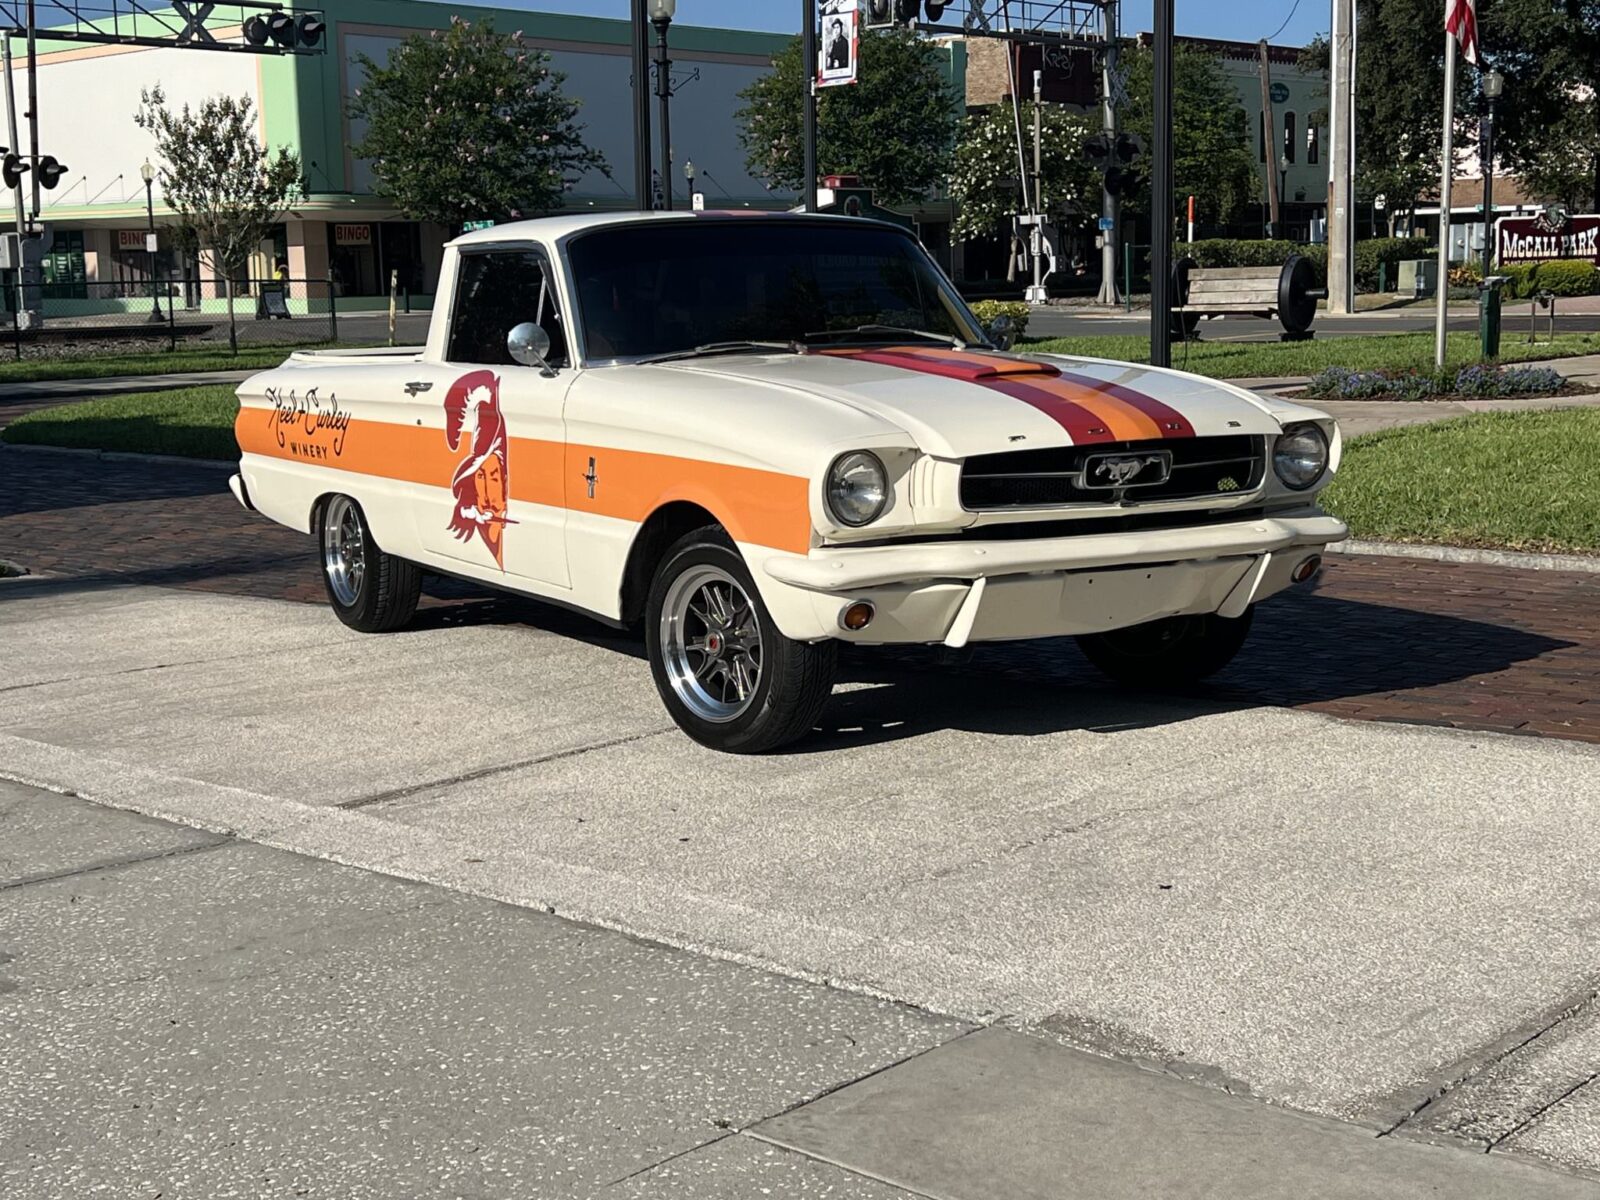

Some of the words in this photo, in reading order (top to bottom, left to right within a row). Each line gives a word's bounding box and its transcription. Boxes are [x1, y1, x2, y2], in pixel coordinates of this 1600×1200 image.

[336, 225, 369, 240] BINGO
[1502, 228, 1559, 259] McCALL
[1560, 226, 1599, 257] PARK
[290, 441, 328, 460] WINERY
